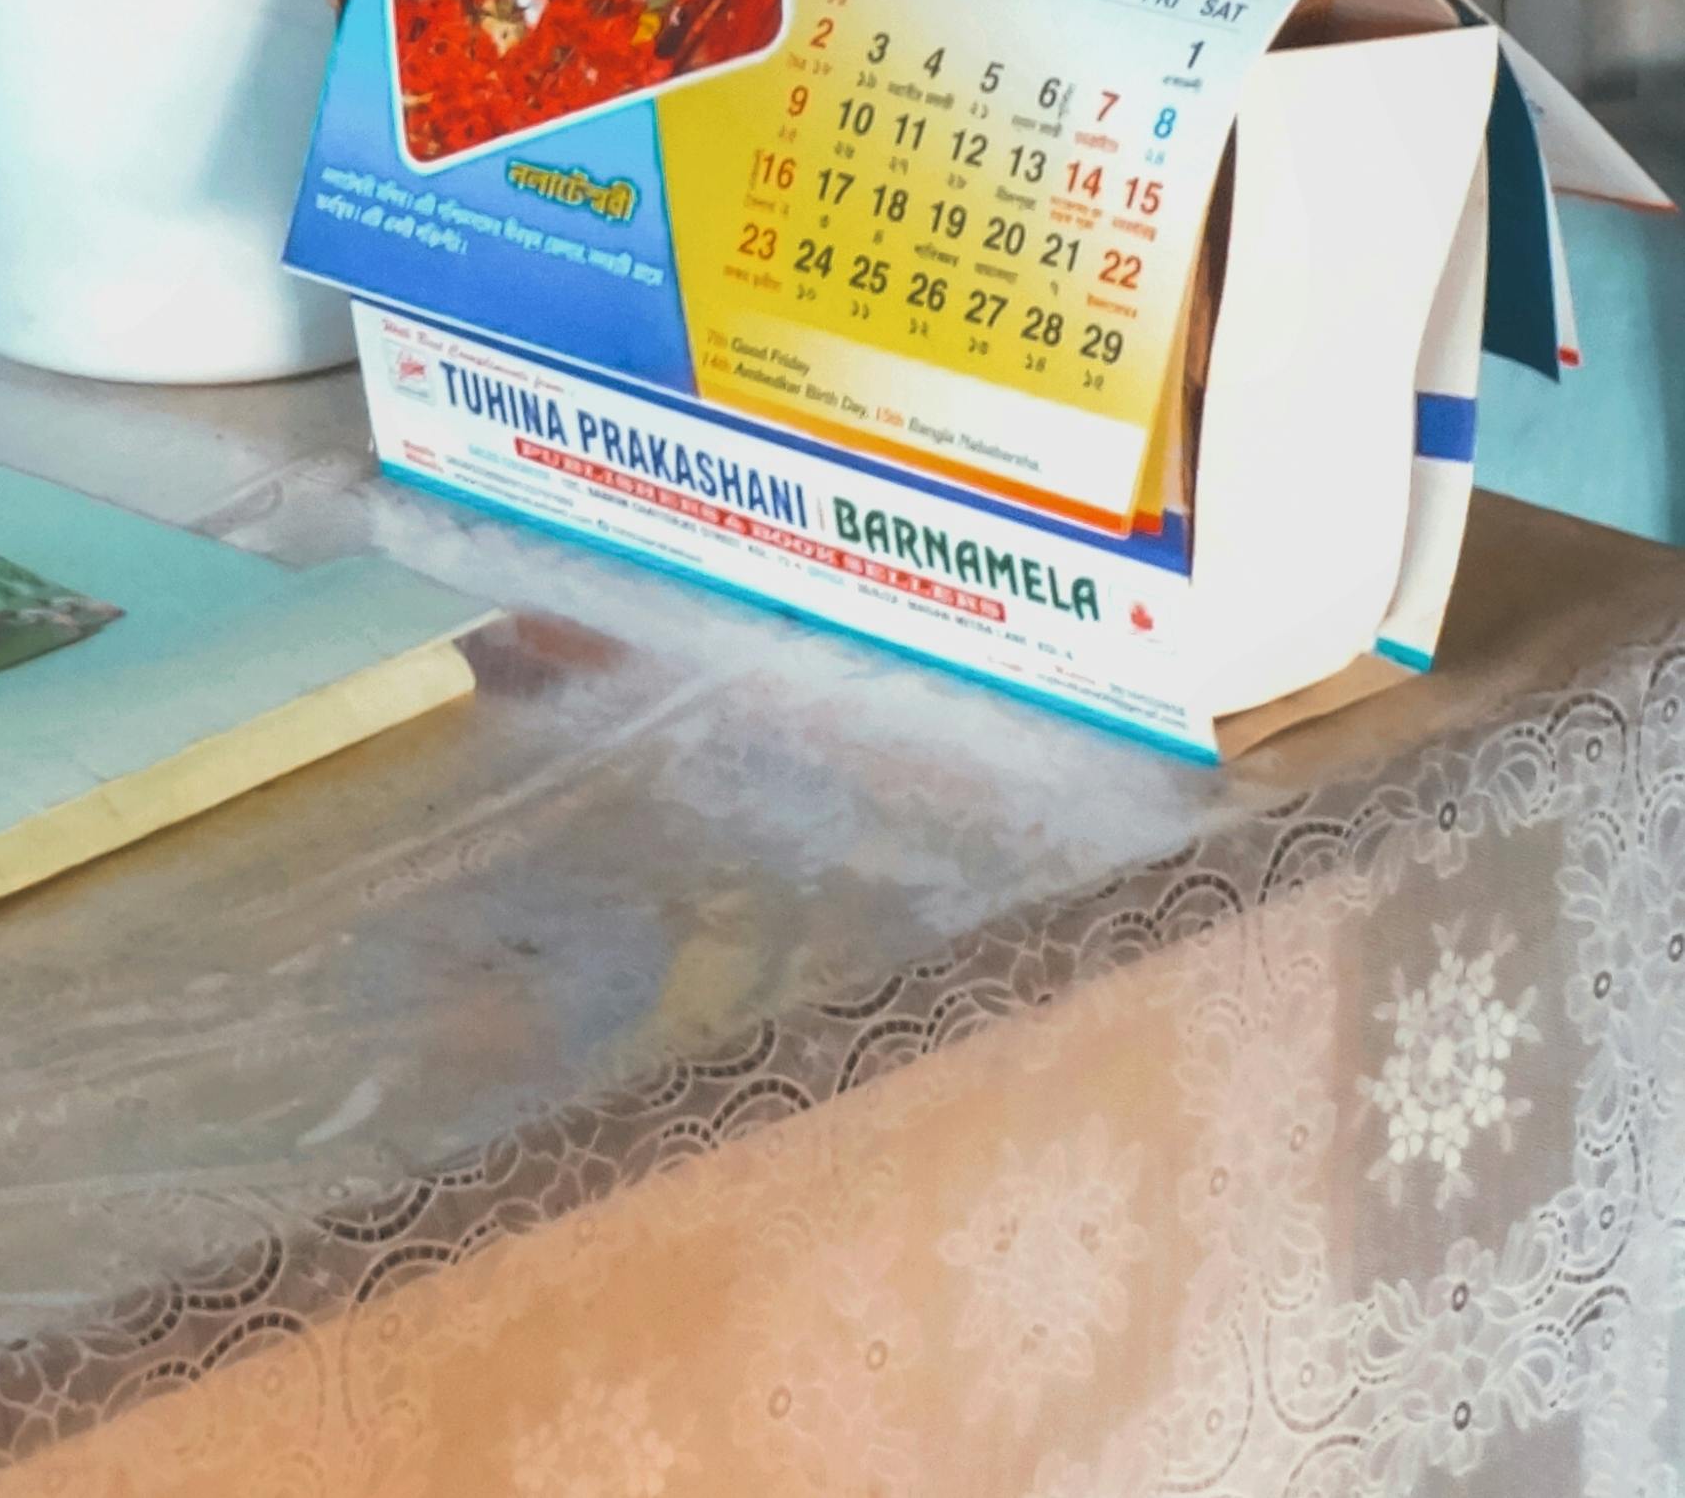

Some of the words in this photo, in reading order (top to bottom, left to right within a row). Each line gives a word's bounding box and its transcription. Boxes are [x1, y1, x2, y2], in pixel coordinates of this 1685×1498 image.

[810, 17, 834, 49] 2
[867, 32, 890, 64] 3
[923, 47, 945, 78] 4
[980, 62, 1005, 93] 5
[1038, 77, 1062, 109] 6
[1097, 91, 1121, 123] 7
[1153, 106, 1177, 139] 8
[1186, 40, 1205, 70] 1
[787, 85, 809, 117] 9
[838, 98, 875, 137] 10
[894, 113, 927, 151] 11
[951, 128, 988, 167] 12
[1010, 145, 1047, 183] 13
[1067, 160, 1104, 199] 14
[1125, 177, 1163, 215] 15
[761, 153, 796, 190] 16
[818, 168, 855, 205] 17
[872, 183, 909, 222] 18
[930, 200, 967, 240] 19
[983, 216, 1025, 256] 20
[1040, 233, 1080, 273] 21
[1099, 250, 1143, 290] 22
[737, 222, 777, 261] 23
[794, 238, 835, 279] 24
[849, 254, 891, 295] 25
[907, 271, 948, 313] 26
[964, 288, 1009, 329] 27
[1021, 305, 1065, 348] 28
[1079, 322, 1124, 366] 29
[439, 360, 569, 446] TUHINA
[576, 407, 809, 529] PRAKASHANI
[521, 441, 717, 525] PUBLISHERS
[752, 524, 834, 568] BOOK
[844, 552, 1004, 620] SELLERS
[832, 495, 1101, 622] BARNAMELA
